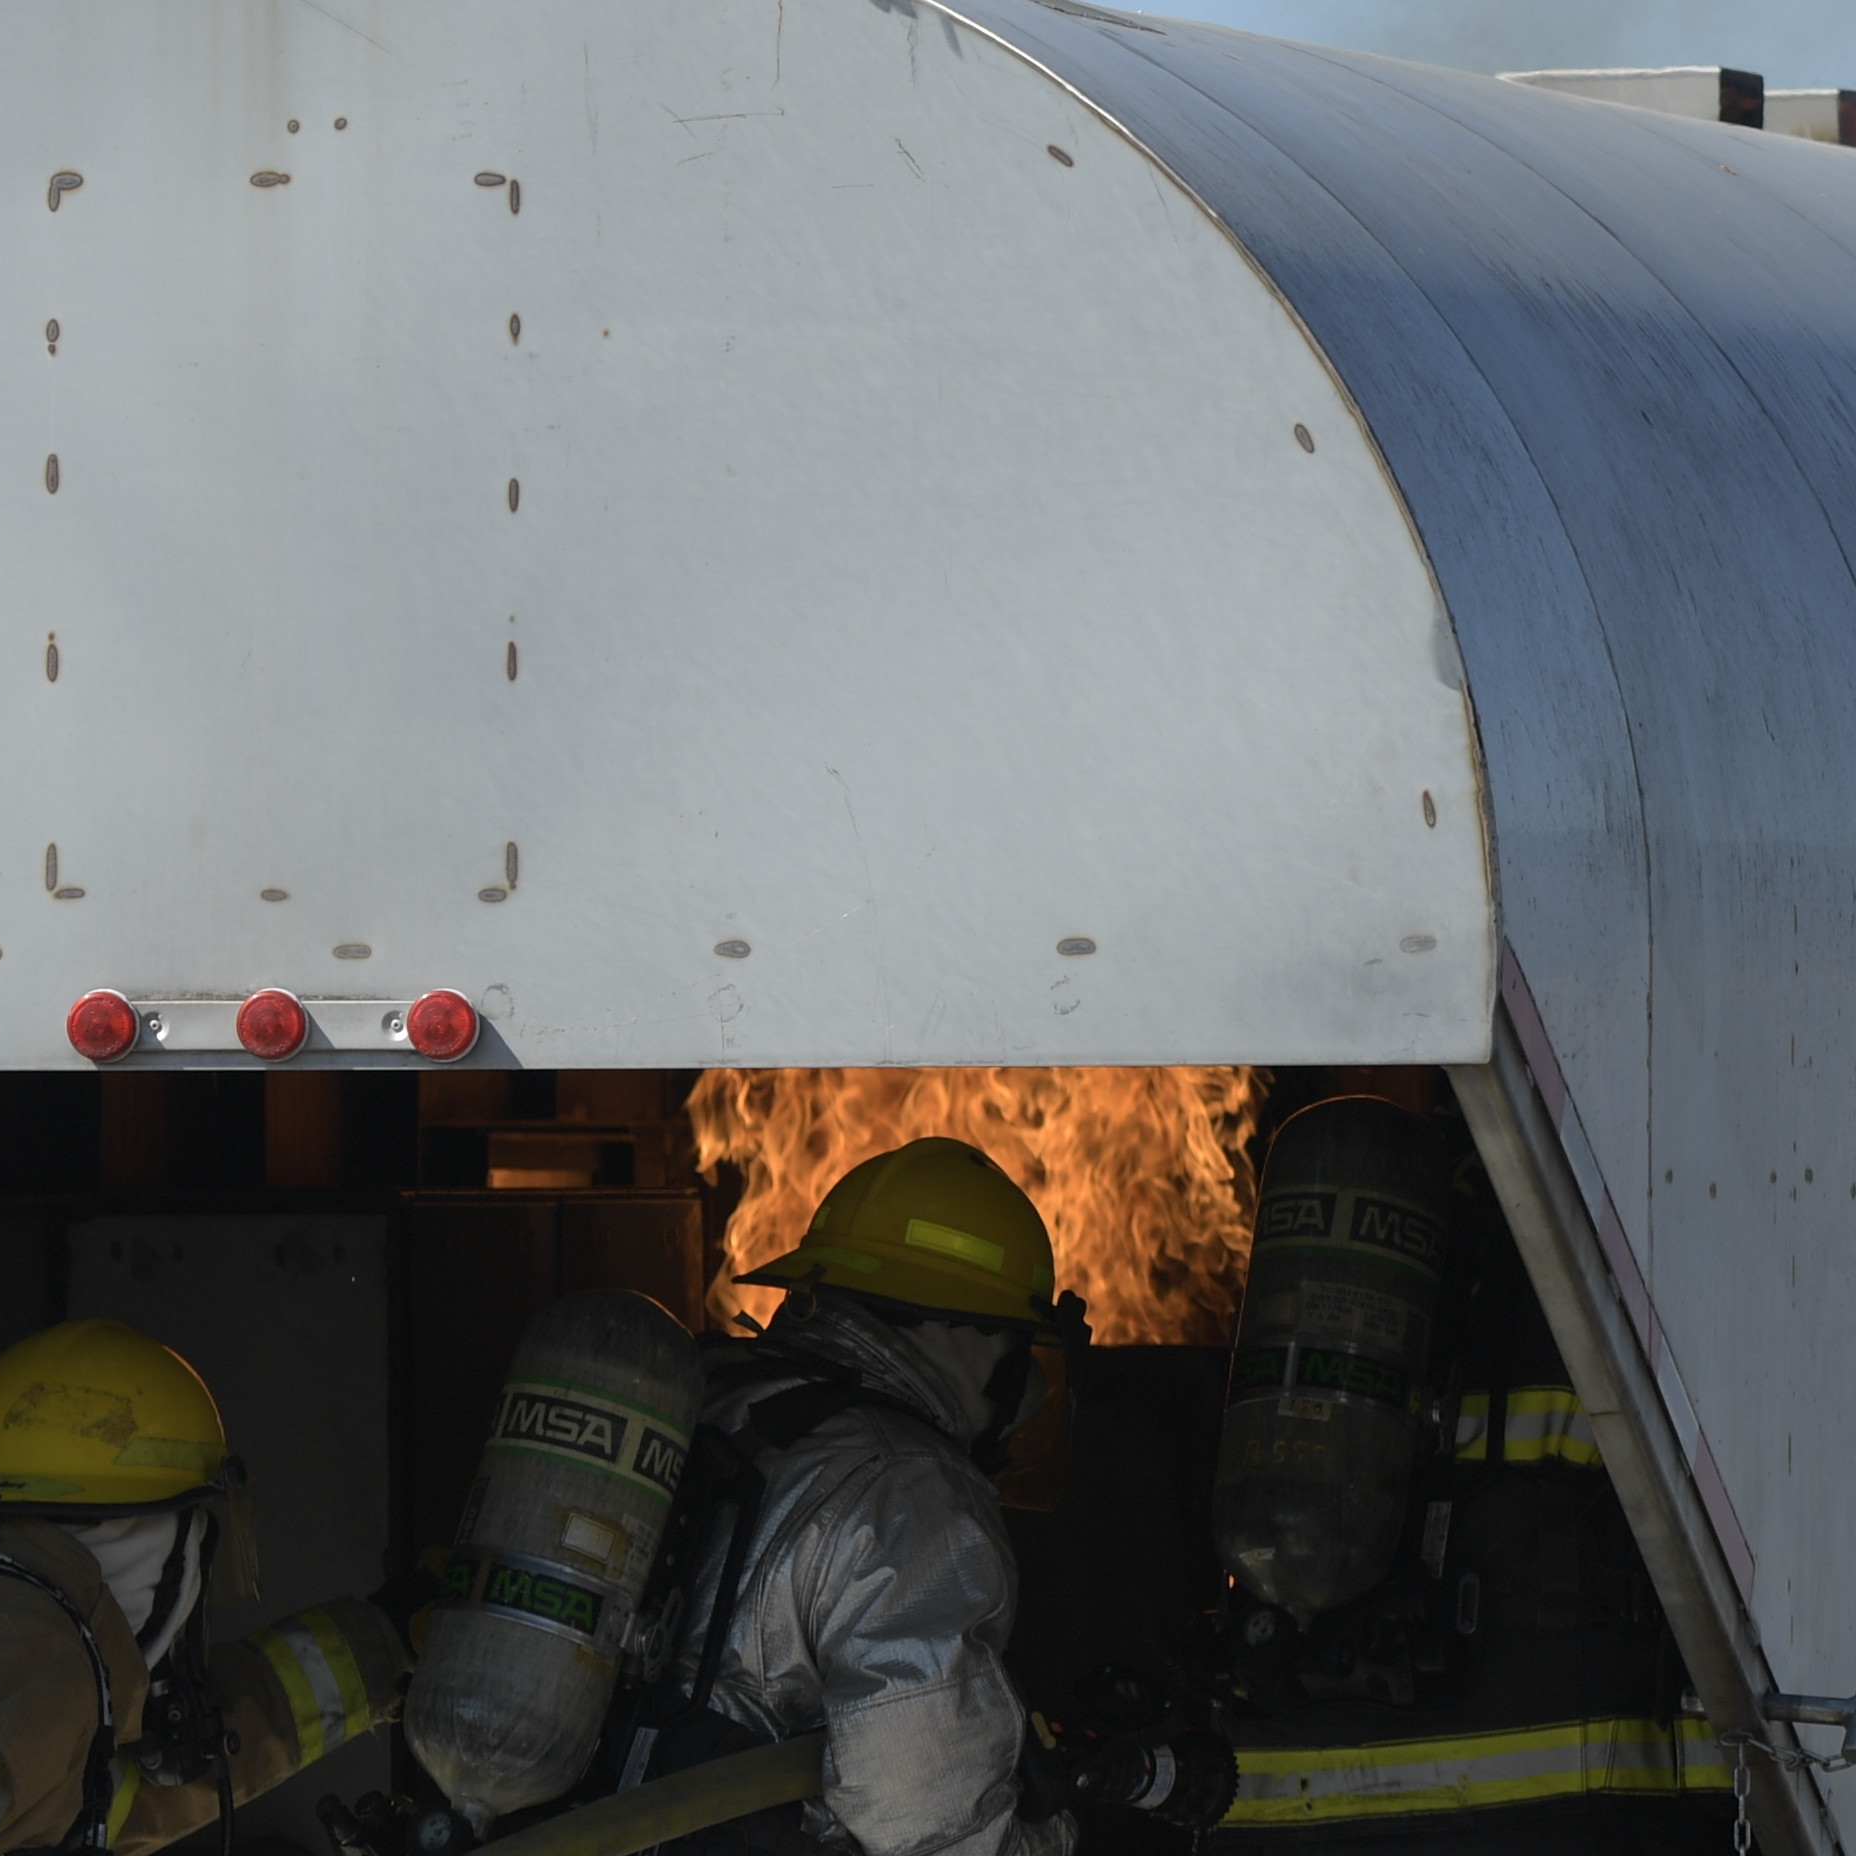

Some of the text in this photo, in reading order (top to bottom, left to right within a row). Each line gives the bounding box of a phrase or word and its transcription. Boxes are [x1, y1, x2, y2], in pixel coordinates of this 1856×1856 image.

[507, 1400, 685, 1490] MSA MS
[490, 1569, 594, 1629] MSA
